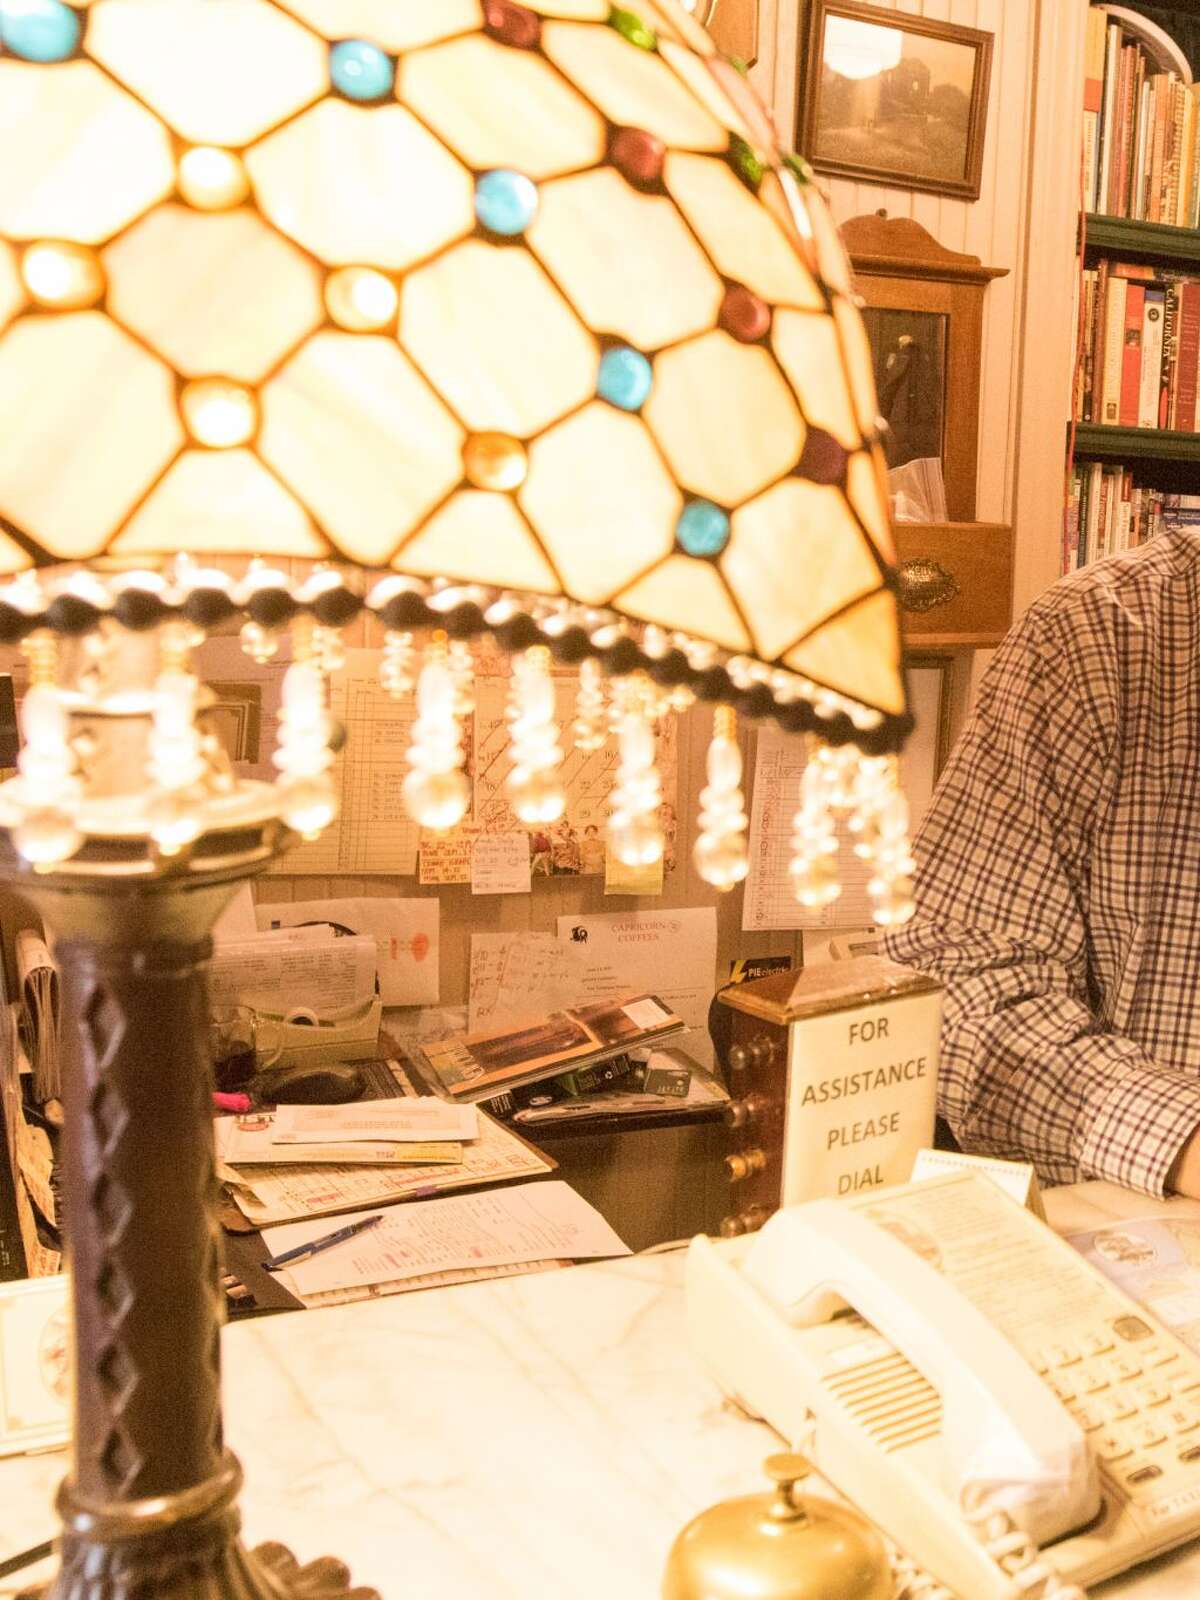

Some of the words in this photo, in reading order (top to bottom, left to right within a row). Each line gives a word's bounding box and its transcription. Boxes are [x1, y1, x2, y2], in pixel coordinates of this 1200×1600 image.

[1163, 289, 1174, 357] CALIFORNIA
[611, 921, 665, 933] CAPRICORN
[618, 932, 660, 944] COFFEES
[848, 1018, 889, 1046] FOR
[801, 1057, 928, 1107] ASSISTANCE
[827, 1112, 901, 1151] PLEASE
[838, 1165, 884, 1196] DIAL
